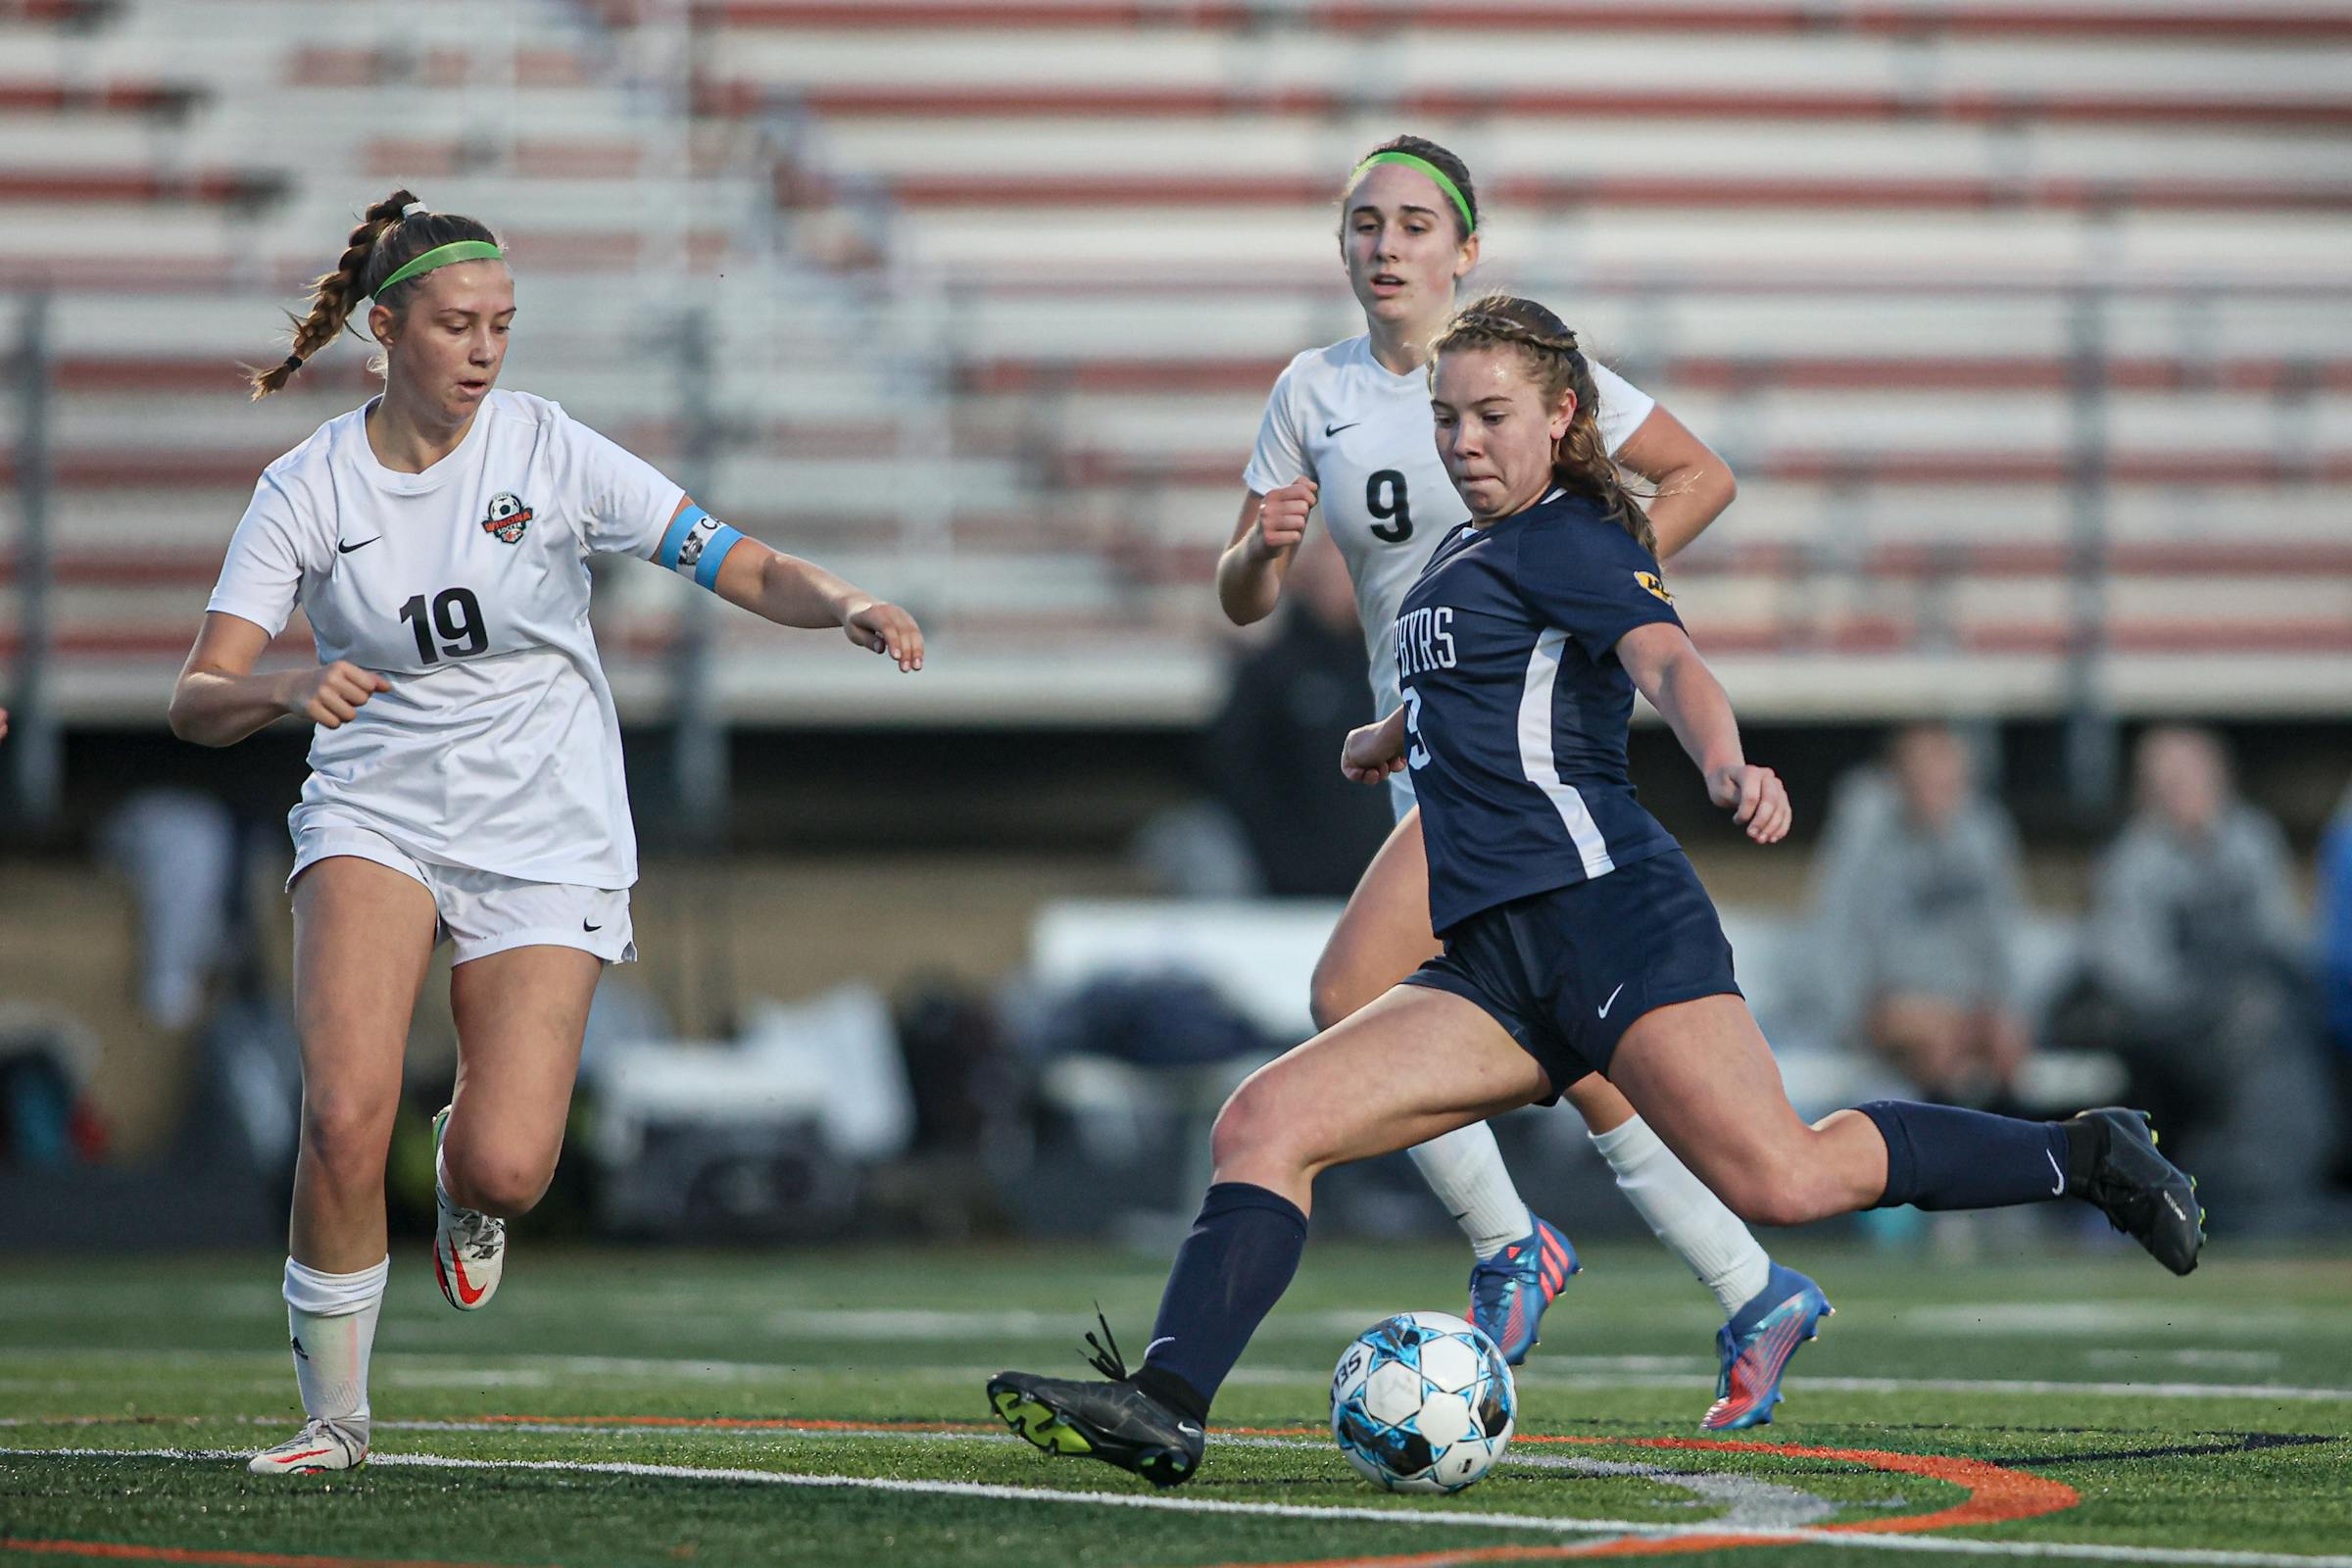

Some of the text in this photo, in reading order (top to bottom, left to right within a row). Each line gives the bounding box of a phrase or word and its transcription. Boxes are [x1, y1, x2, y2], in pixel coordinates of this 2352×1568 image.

[484, 510, 531, 532] WINONA
[496, 520, 524, 535] SOCCER
[1366, 468, 1414, 543] 9
[399, 587, 489, 664] 19
